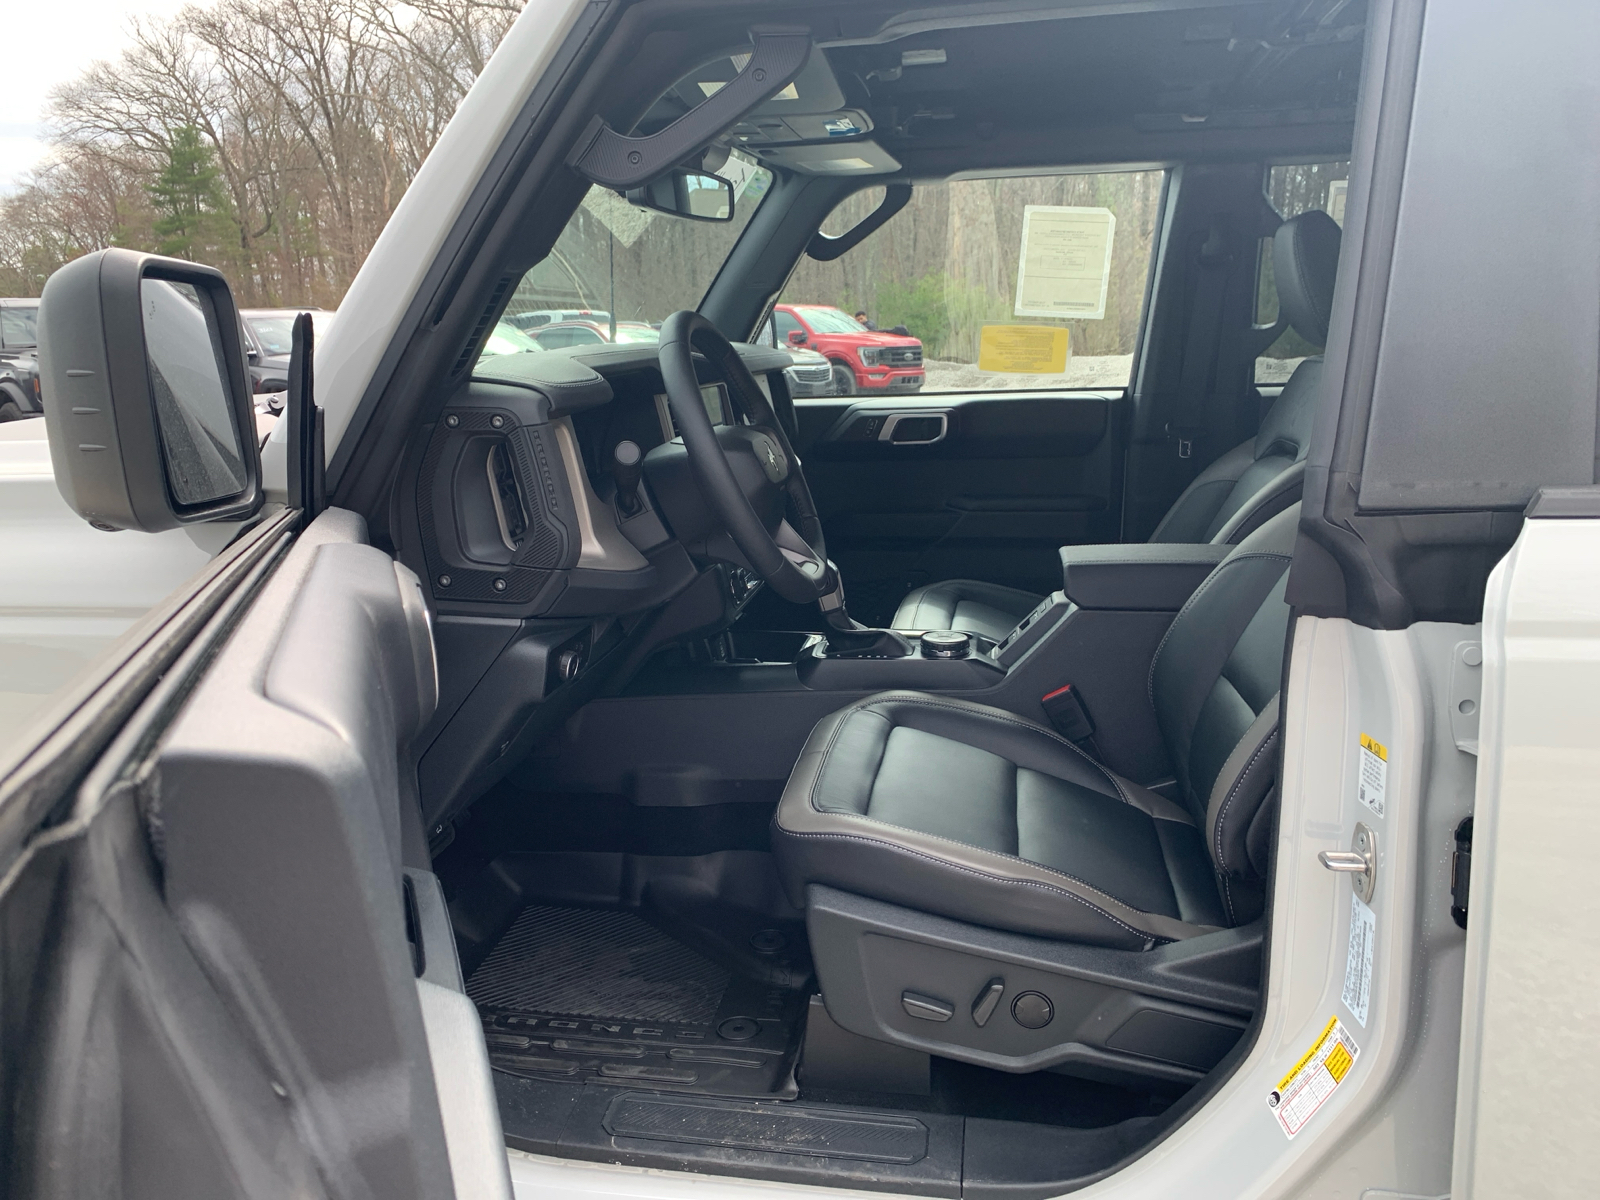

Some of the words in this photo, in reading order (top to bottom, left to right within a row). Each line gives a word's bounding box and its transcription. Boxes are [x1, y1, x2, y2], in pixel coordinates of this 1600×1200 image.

[533, 430, 558, 511] BRONCO
[482, 1014, 706, 1039] RONCO
[1280, 1080, 1289, 1089] TIRE
[1289, 1069, 1298, 1079] AND
[1298, 1052, 1315, 1070] LOADING
[1314, 1018, 1337, 1051] INFORMATION
